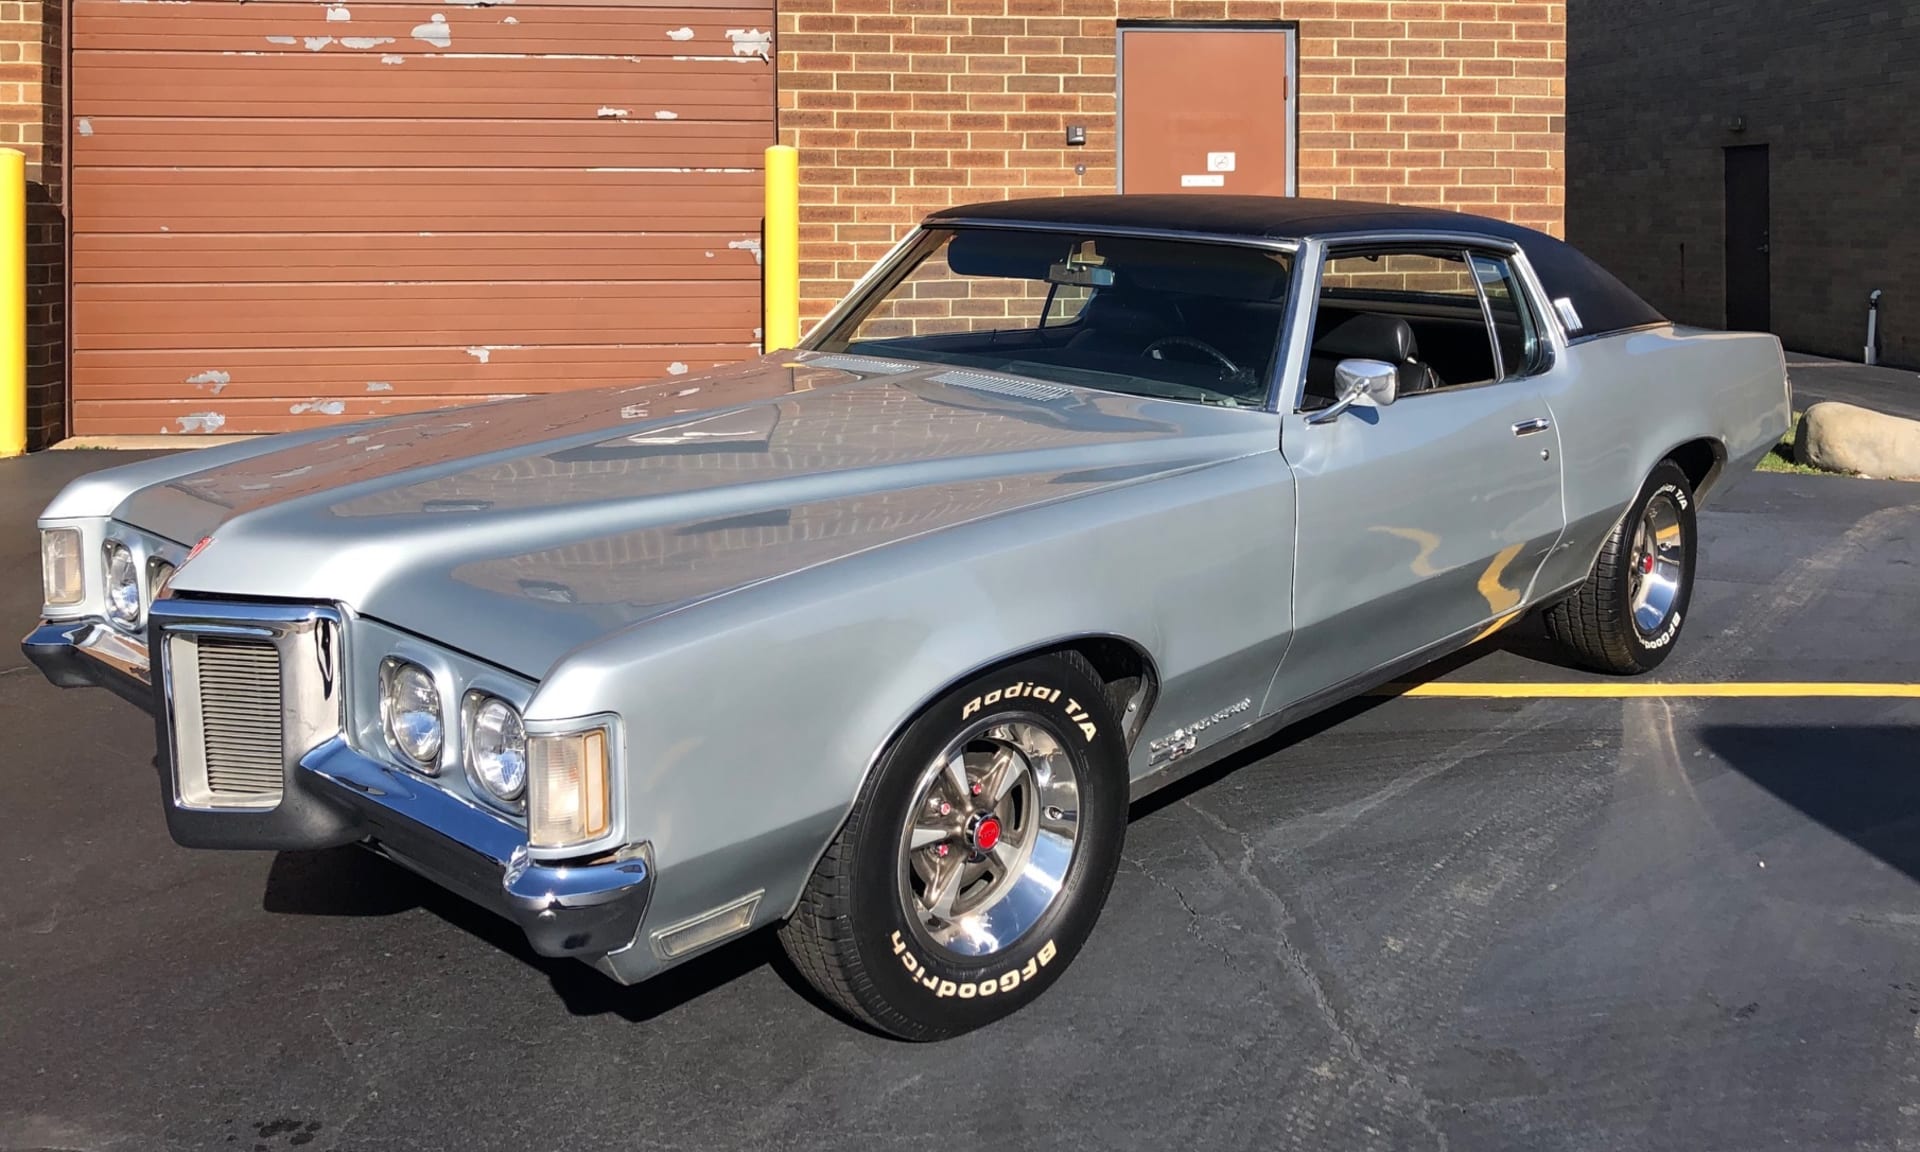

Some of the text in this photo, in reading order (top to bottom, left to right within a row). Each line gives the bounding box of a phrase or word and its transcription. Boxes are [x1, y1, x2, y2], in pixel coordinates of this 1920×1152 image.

[1675, 488, 1688, 511] T/A
[1637, 611, 1681, 649] BFGood
[962, 681, 1098, 743] Radial T/A
[890, 929, 1058, 999] BFGoodrich
